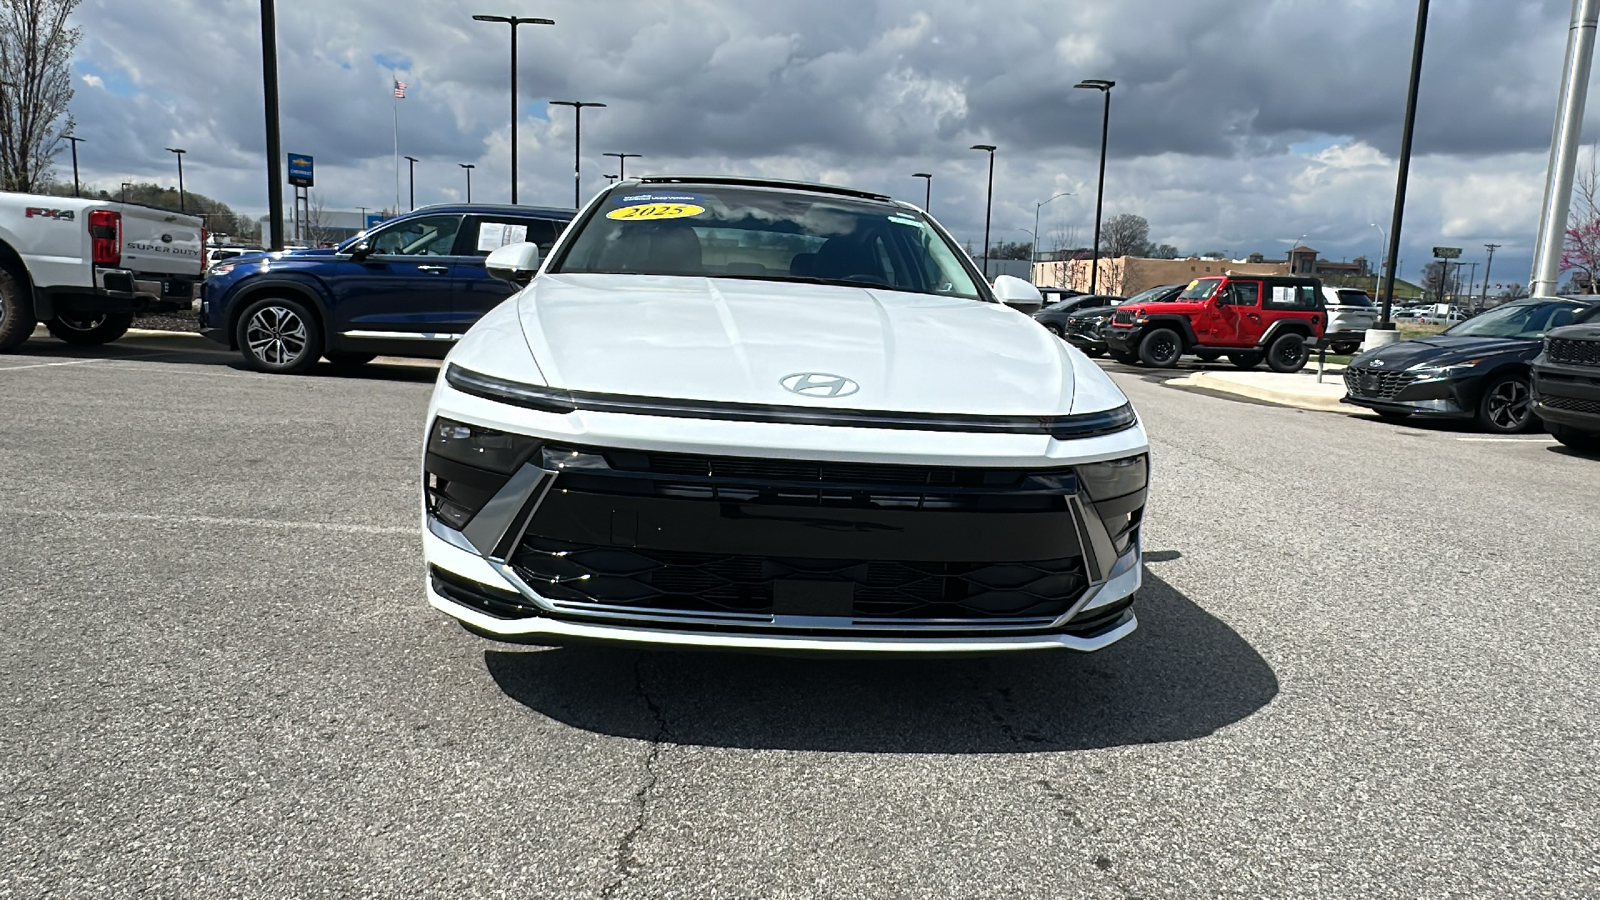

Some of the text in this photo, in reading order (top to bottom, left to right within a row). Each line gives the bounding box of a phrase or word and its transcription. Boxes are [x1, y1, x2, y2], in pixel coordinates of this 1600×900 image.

[25, 206, 75, 219] FX4
[623, 206, 684, 218] 2025
[127, 242, 199, 256] SUPER DUTY
